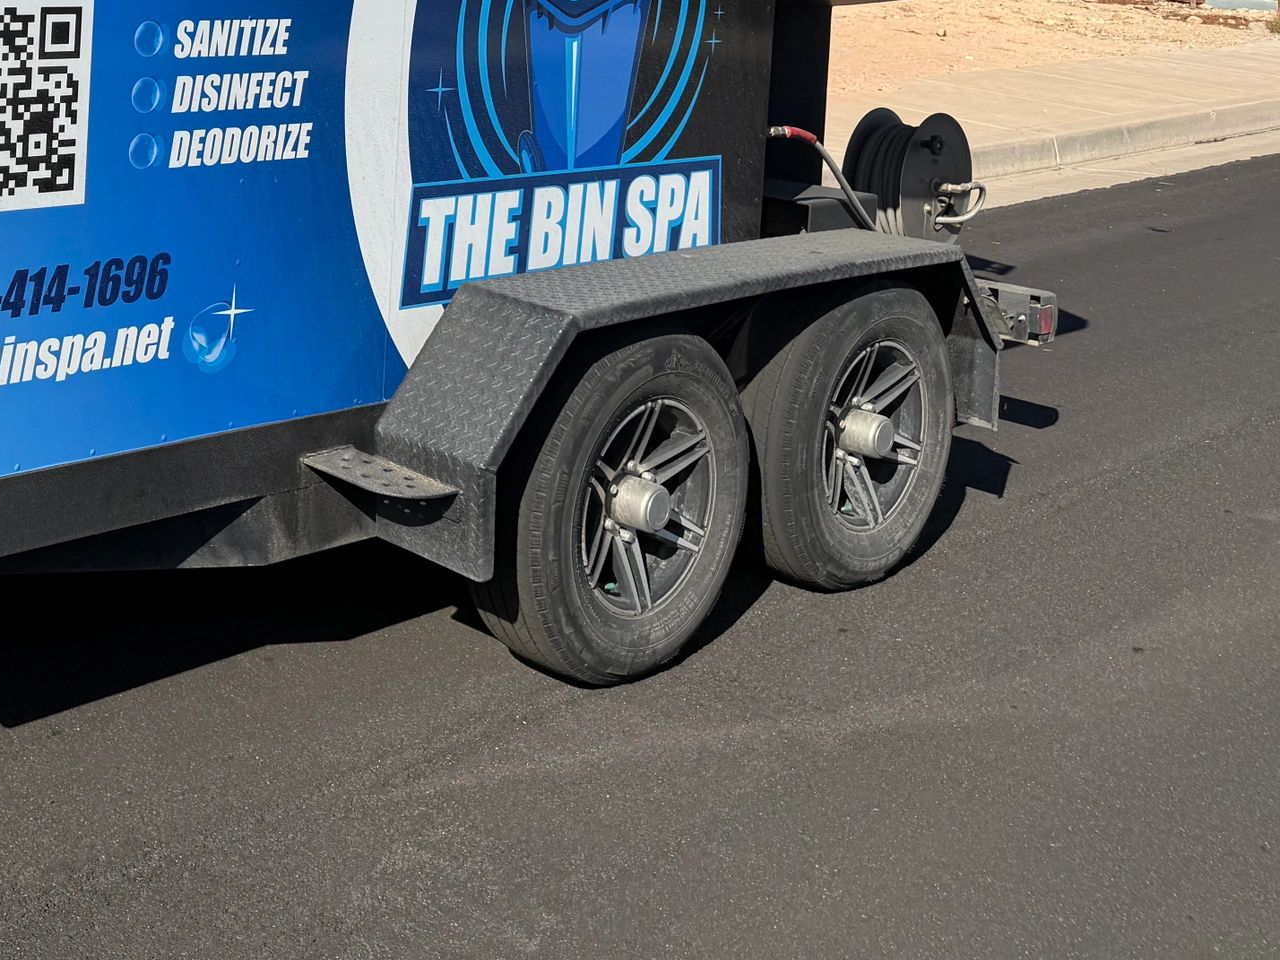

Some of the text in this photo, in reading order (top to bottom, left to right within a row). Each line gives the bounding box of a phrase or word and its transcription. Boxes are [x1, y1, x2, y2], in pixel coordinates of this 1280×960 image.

[173, 18, 293, 59] SANITIZE
[171, 70, 309, 113] DISINFECT
[168, 122, 313, 169] DEODORIZE
[420, 169, 711, 287] THE BIN SPA
